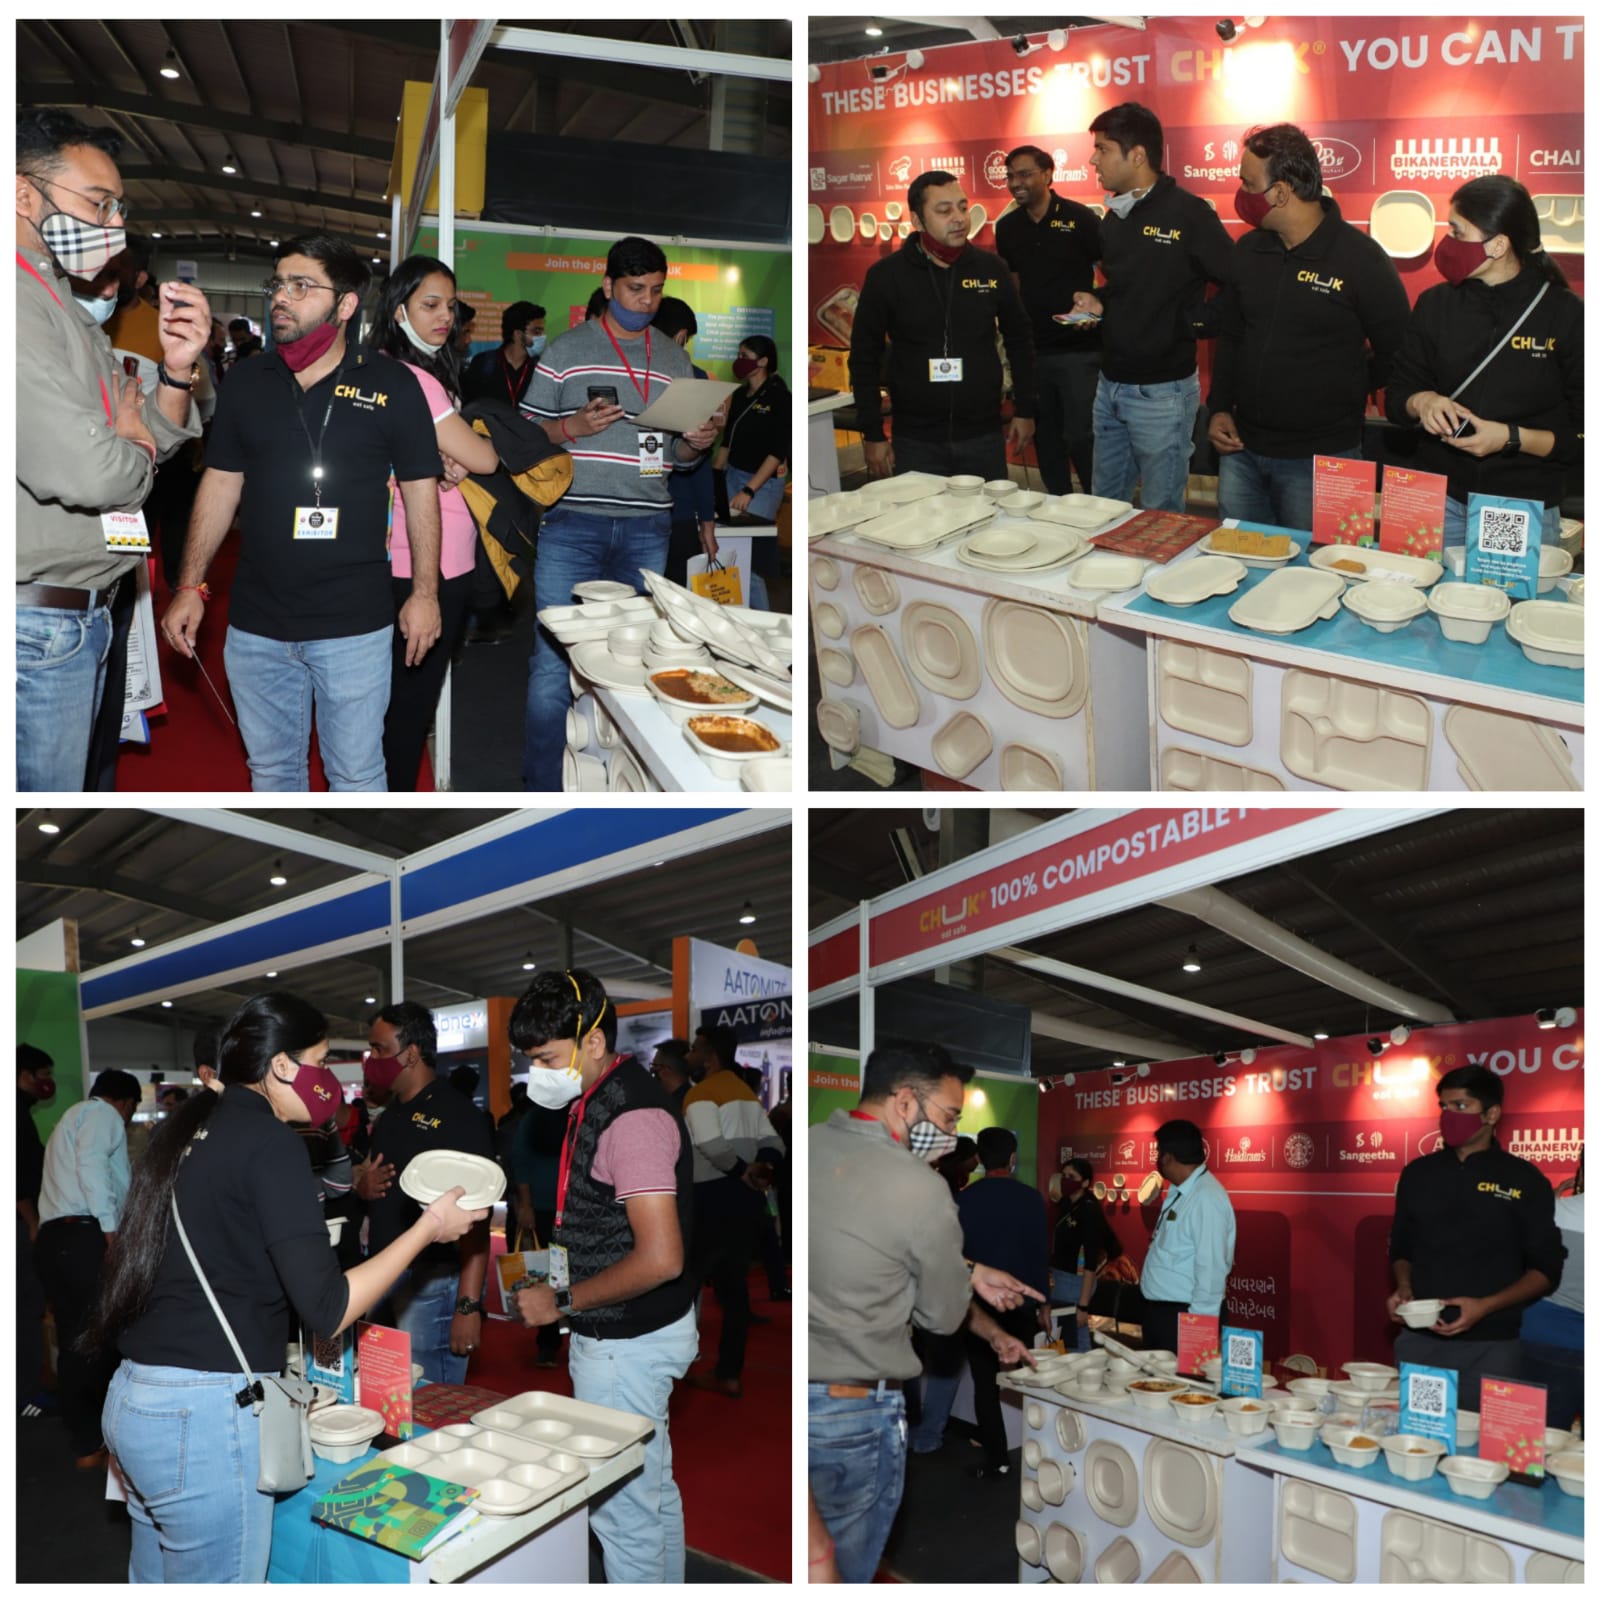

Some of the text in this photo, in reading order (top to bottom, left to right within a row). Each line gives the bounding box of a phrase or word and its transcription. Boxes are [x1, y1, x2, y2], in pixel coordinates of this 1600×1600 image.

[822, 85, 886, 115] THESE
[893, 66, 1044, 108] BUSINESSES
[1340, 34, 1428, 72] YOU
[1441, 27, 1541, 66] CAN
[1393, 155, 1499, 168] BIKANERVALA
[1530, 148, 1582, 167] CHAI
[1184, 164, 1242, 182] Sangeet
[1143, 225, 1181, 241] CHUK
[545, 258, 569, 270] Join
[572, 259, 590, 271] the
[962, 279, 998, 289] CHUK
[1297, 270, 1344, 292] CHUK
[1511, 336, 1556, 351] CHUK
[334, 384, 388, 407] CHUK
[990, 872, 1038, 909] 100%
[1043, 808, 1231, 890] COMPOSTABLE
[815, 1074, 839, 1086] Join
[1075, 1088, 1121, 1110] THESE
[1126, 1076, 1237, 1106] BUSINESSES
[1245, 1066, 1317, 1095] TRUST
[1466, 1047, 1542, 1077] YOU
[1552, 1043, 1585, 1071] C
[1339, 1150, 1397, 1163] Sangeetha
[1477, 1182, 1522, 1199] CHUK
